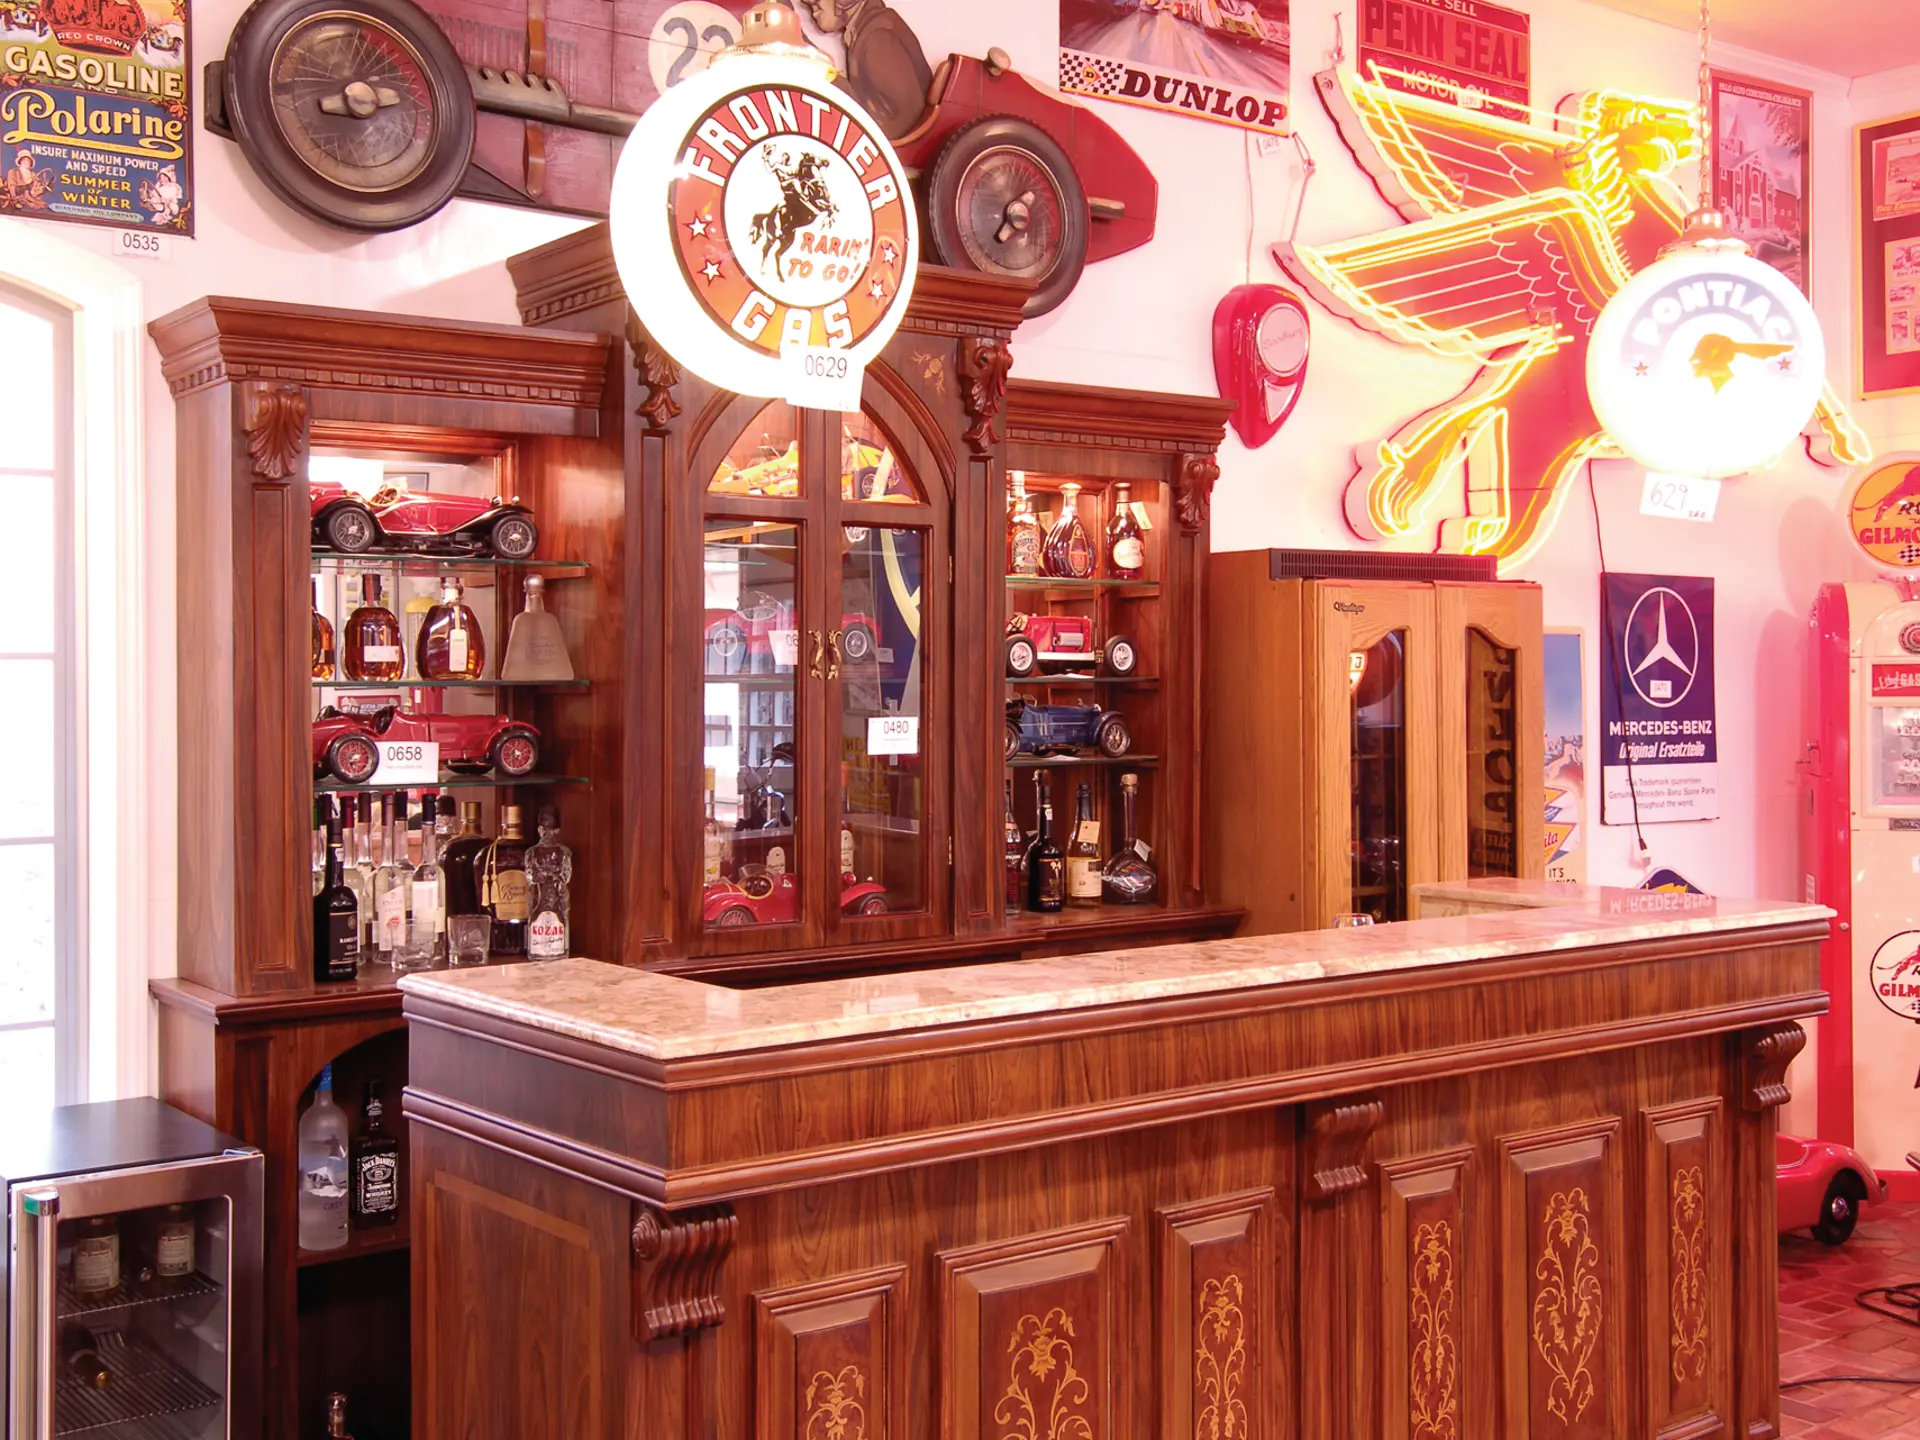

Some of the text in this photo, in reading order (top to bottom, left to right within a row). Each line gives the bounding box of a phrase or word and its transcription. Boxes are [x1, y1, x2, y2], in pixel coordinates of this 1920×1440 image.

[1444, 0, 1477, 17] SELL
[57, 32, 131, 51] RED CROWN
[1365, 1, 1529, 83] PENN SEAL
[4, 45, 184, 98] GASOLINE
[72, 82, 118, 94] AND
[1402, 66, 1460, 101] MOTOR
[1118, 68, 1288, 127] DUNLOP
[1, 88, 184, 148] Polarine
[31, 144, 69, 159] INSURE
[71, 150, 122, 166] MAXIMUM
[124, 157, 160, 172] POWER
[680, 89, 898, 209] FRONTIER
[65, 160, 127, 178] AND SPEED
[60, 173, 132, 193] SUMMER
[61, 191, 132, 210] WINTER
[123, 232, 160, 252] 0535
[788, 258, 861, 283] TO GO!
[730, 290, 854, 354] GAS
[1631, 280, 1793, 347] PONTIAC
[805, 354, 848, 379] 0629
[1650, 481, 1688, 511] 629
[883, 720, 909, 734] 0480
[1609, 720, 1713, 736] MERCEDES-BENZ
[387, 746, 423, 761] 0658
[1659, 740, 1706, 758] Ersatzteile
[1548, 867, 1564, 878] IT'S
